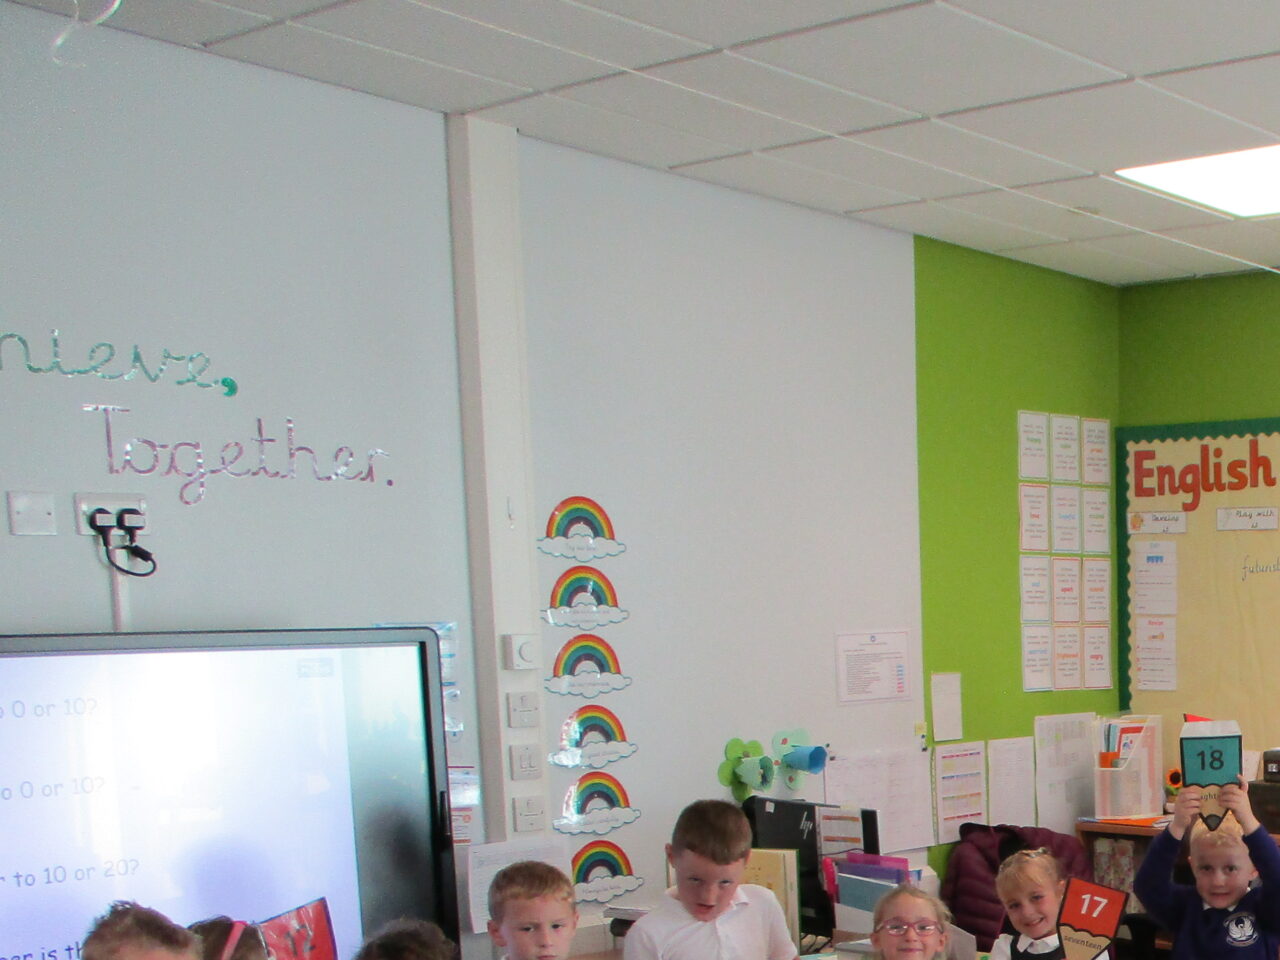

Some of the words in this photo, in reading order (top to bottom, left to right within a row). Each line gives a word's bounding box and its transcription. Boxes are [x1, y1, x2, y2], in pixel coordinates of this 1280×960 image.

[81, 403, 394, 505] Together.
[1133, 438, 1277, 512] English
[1196, 749, 1225, 771] 18
[14, 871, 36, 887] to
[44, 865, 67, 883] 10
[74, 864, 96, 881] or
[1080, 893, 1109, 918] 17
[284, 923, 317, 957] 12
[1063, 935, 1102, 950] seventeen
